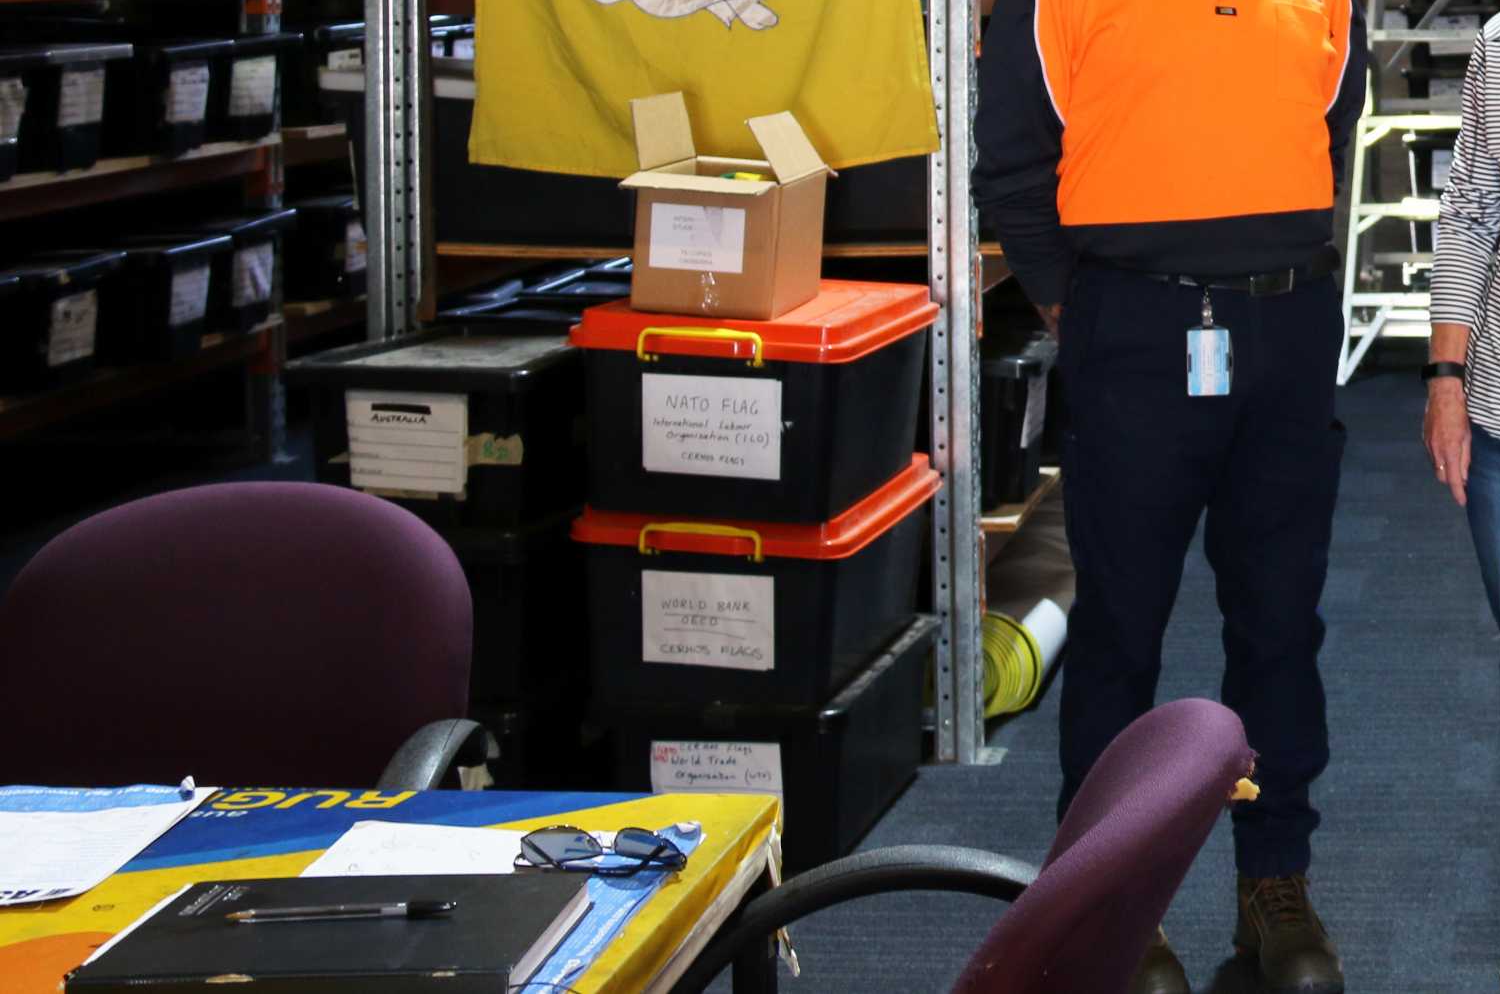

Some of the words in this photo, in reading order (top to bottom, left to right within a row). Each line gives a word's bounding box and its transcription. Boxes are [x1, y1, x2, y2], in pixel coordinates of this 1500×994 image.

[665, 394, 710, 411] NATO
[370, 413, 427, 424] AUSTRALIA
[660, 597, 707, 610] WORLD
[716, 600, 752, 613] BANK
[203, 790, 418, 809] RUG
